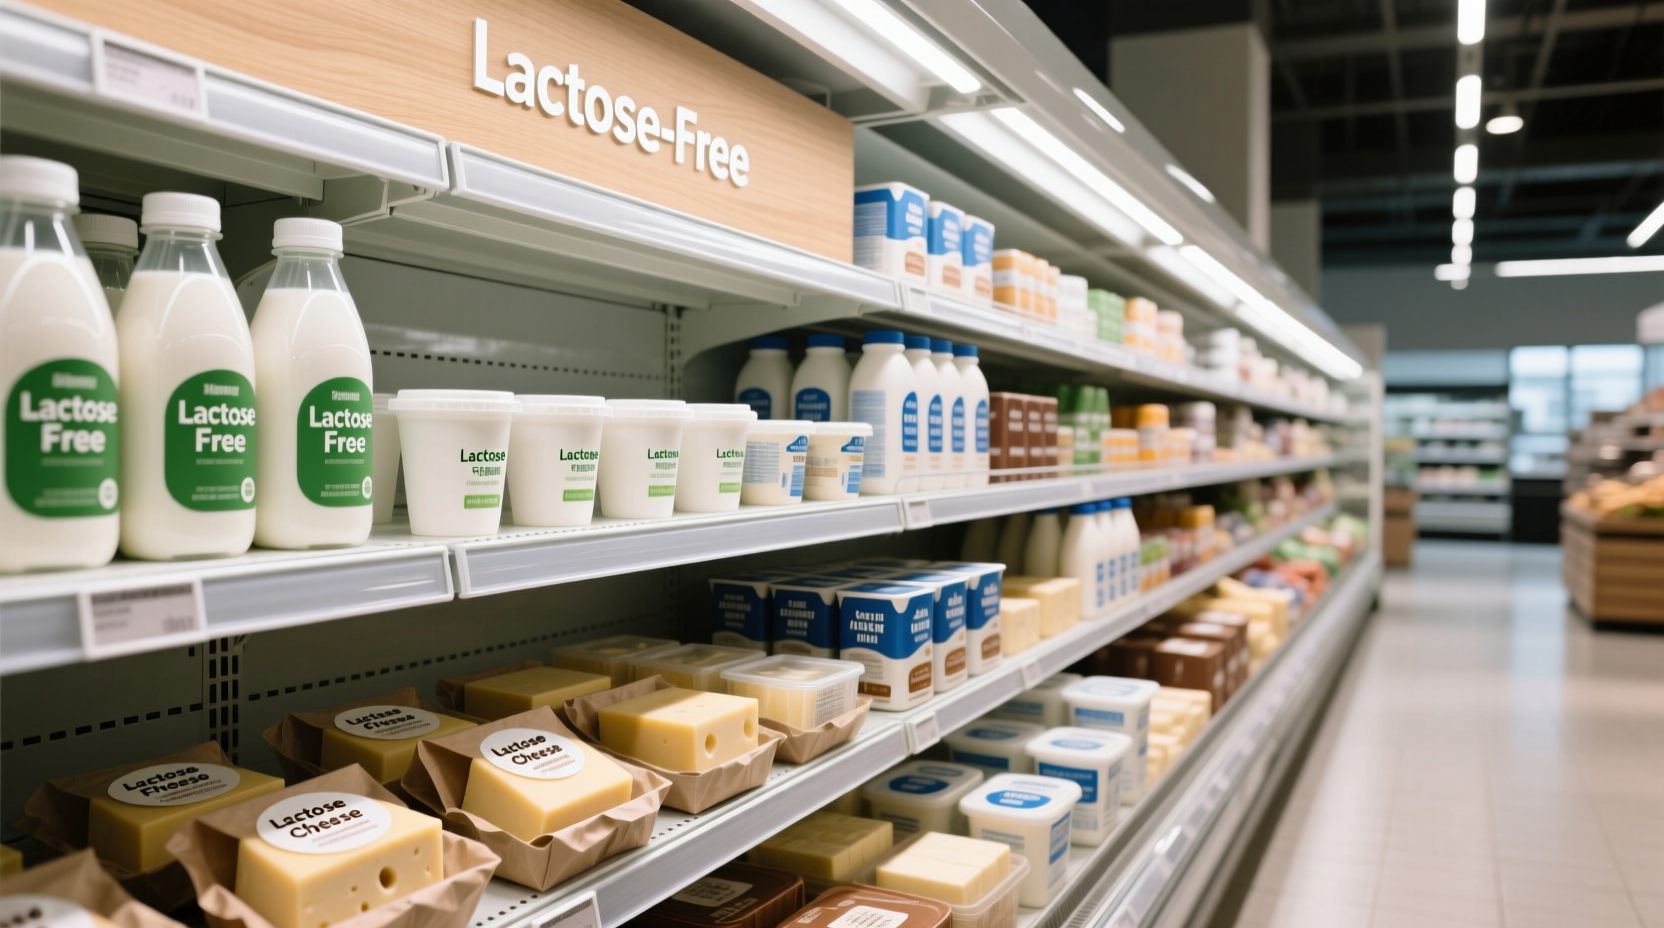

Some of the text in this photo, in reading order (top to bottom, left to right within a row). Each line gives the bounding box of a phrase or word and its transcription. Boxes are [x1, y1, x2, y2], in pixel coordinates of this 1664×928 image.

[473, 17, 749, 187] Lactose-Free
[20, 391, 118, 423] Lactose
[178, 399, 256, 426] Lactose
[309, 405, 373, 428] Lactose
[41, 422, 106, 453] Free
[195, 427, 246, 453] Free
[324, 431, 366, 453] Free
[460, 449, 506, 463] Lactose
[268, 800, 347, 829] Lactose
[289, 809, 364, 838] Cheese
